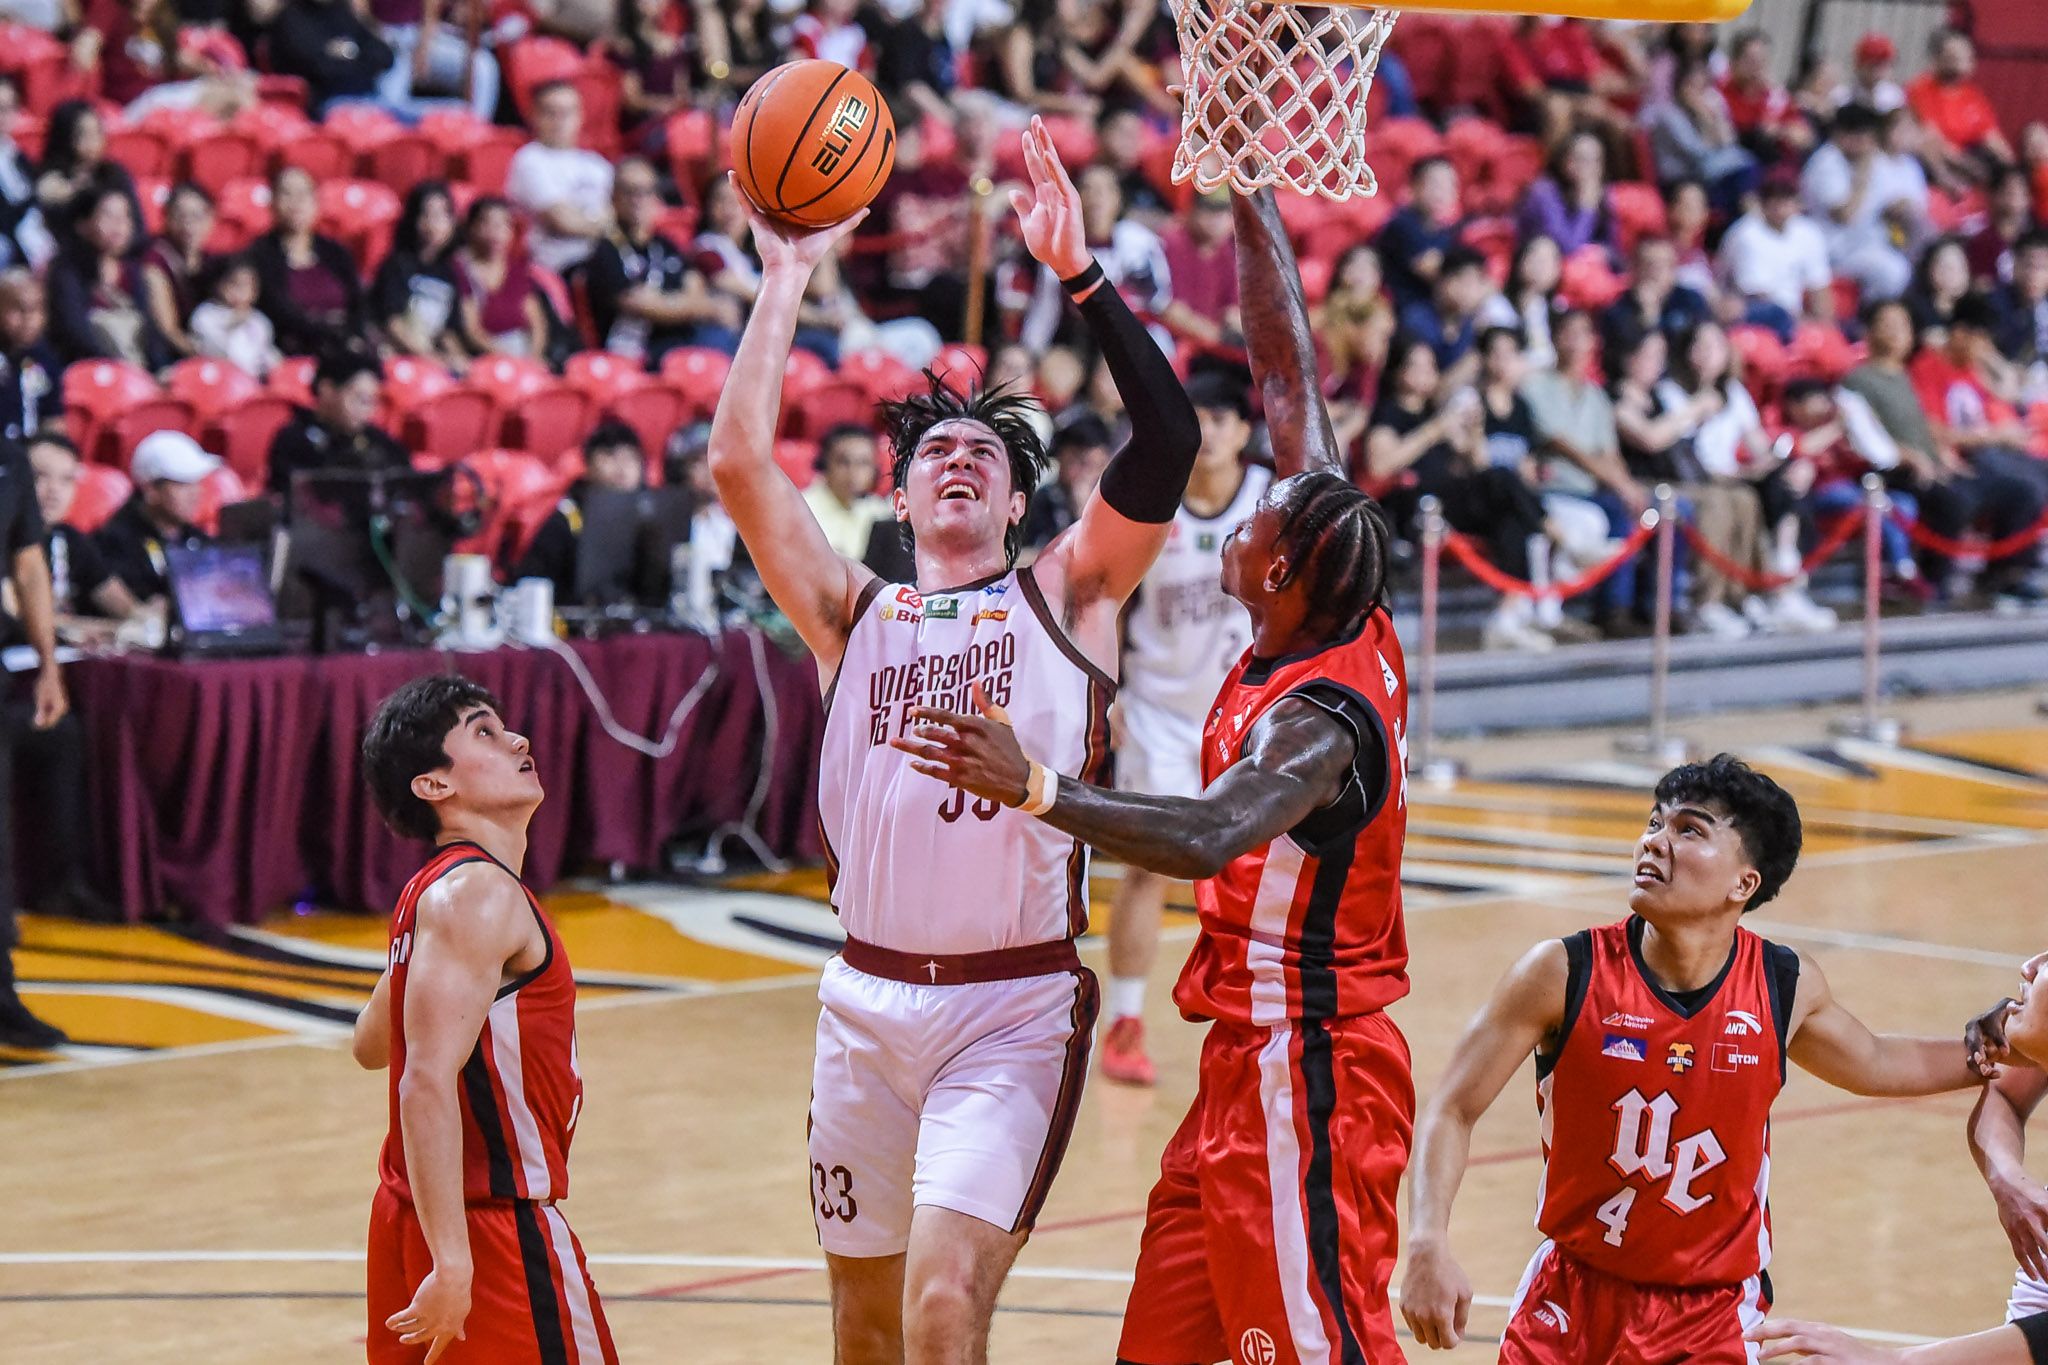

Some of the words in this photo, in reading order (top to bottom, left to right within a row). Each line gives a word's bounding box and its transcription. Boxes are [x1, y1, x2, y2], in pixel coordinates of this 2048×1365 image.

[811, 95, 869, 176] ELITE
[1724, 1023, 1747, 1035] ANTA
[813, 1161, 858, 1223] 33
[1596, 1186, 1638, 1248] 4
